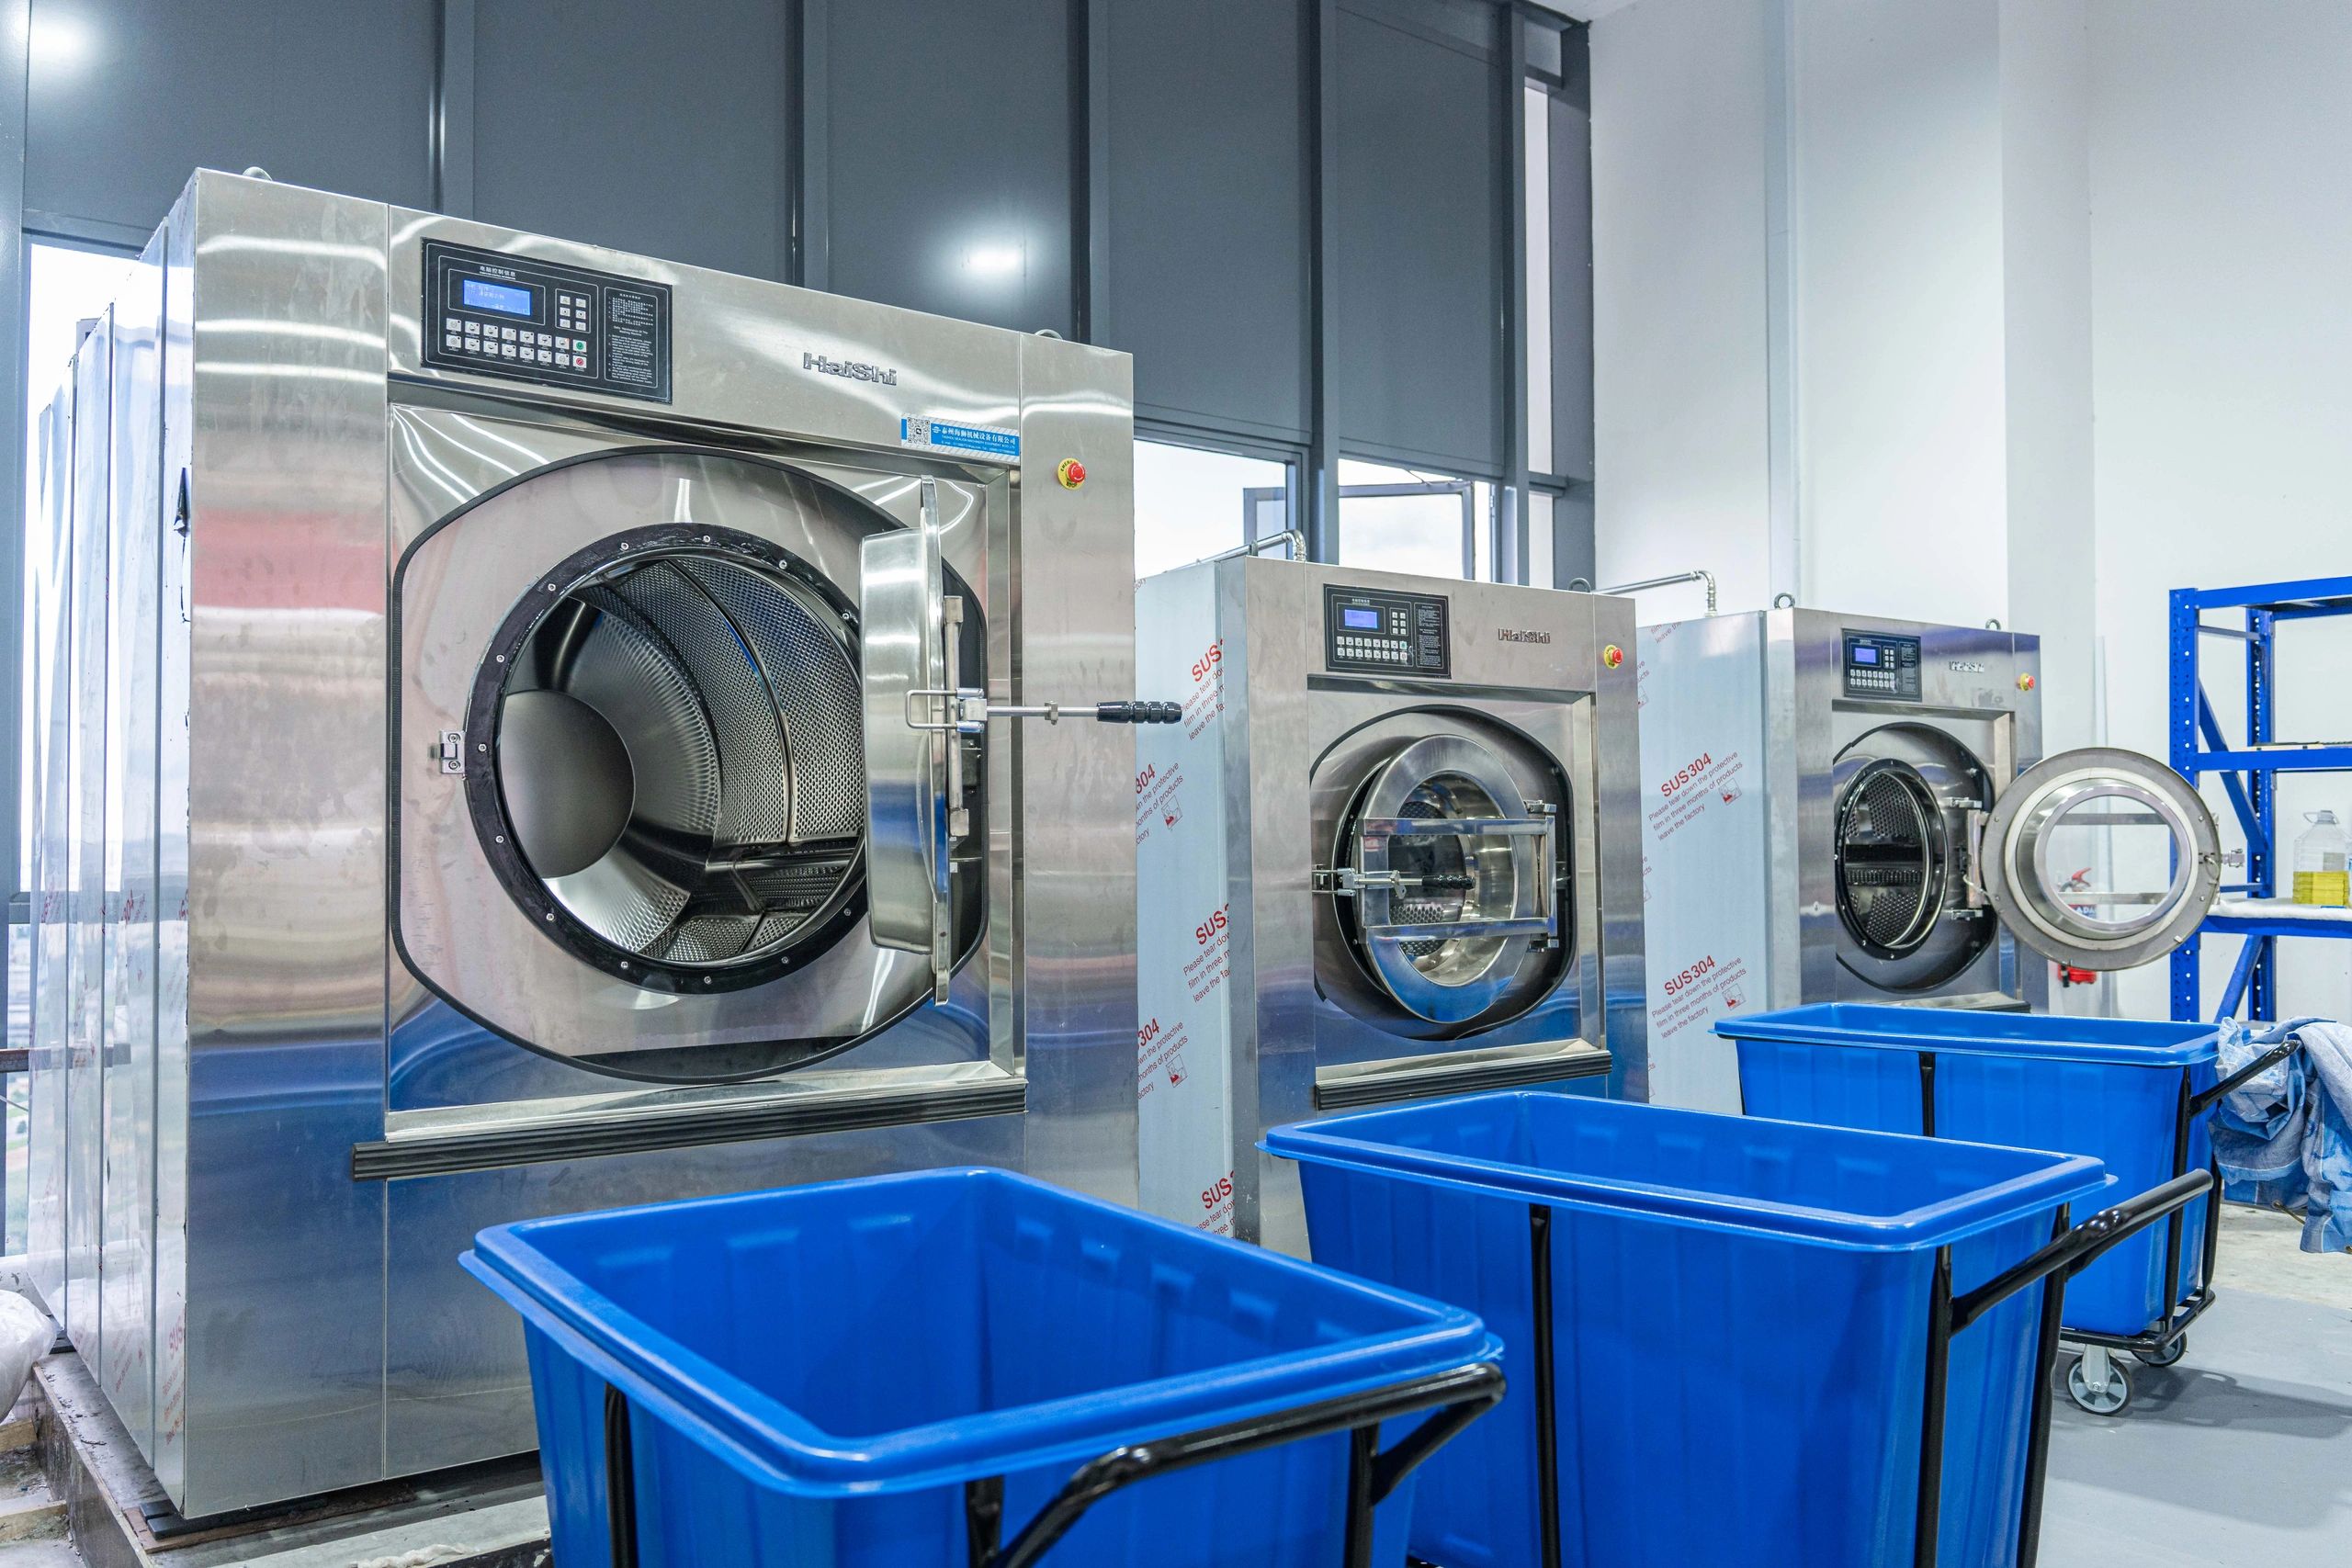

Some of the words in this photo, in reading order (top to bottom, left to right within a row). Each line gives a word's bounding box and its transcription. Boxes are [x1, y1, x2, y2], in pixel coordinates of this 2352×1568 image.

[803, 352, 897, 386] HaiShi
[1192, 638, 1224, 682] SUS
[1183, 714, 1195, 728] film
[1194, 706, 1202, 716] in
[1202, 691, 1218, 709] three
[1188, 720, 1205, 740] leave
[1204, 709, 1216, 723] the
[1142, 791, 1152, 804] the
[1152, 762, 1179, 794] protective
[1153, 799, 1159, 809] of
[1159, 774, 1183, 805] products
[1648, 803, 1669, 821] Please
[1668, 795, 1681, 807] tear
[1681, 784, 1698, 797] down
[1697, 774, 1708, 785] the
[1708, 751, 1738, 778] protective
[1660, 752, 1712, 797] SUS304
[1653, 819, 1665, 831] film
[1665, 815, 1671, 824] in
[1670, 804, 1687, 818] three
[1687, 788, 1709, 807] months
[1709, 780, 1716, 790] of
[1716, 761, 1743, 785] products
[1657, 826, 1675, 841] leave
[1674, 818, 1685, 829] the
[1684, 803, 1705, 822] factory
[1195, 903, 1229, 945] SUS
[1183, 954, 1204, 976] Please
[1204, 943, 1216, 958] tear
[1188, 976, 1200, 989] film
[1199, 970, 1206, 979] in
[1205, 956, 1223, 974] three
[1664, 954, 1715, 996] SUS304
[1193, 985, 1210, 1003] leave
[1209, 976, 1220, 988] the
[1651, 1001, 1672, 1018] Please
[1672, 994, 1684, 1005] tear
[1684, 984, 1701, 997] down
[1701, 976, 1712, 987] the
[1711, 956, 1742, 981] protective
[1656, 1017, 1668, 1029] film
[1668, 1013, 1675, 1021] in
[1674, 1004, 1690, 1017] three
[1690, 990, 1713, 1007] months
[1713, 983, 1720, 993] of
[1720, 967, 1747, 990] products
[1147, 1046, 1157, 1057] the
[1156, 1021, 1183, 1051] protective
[1661, 1026, 1678, 1039] leave
[1677, 1019, 1688, 1029] the
[1688, 1006, 1709, 1022] factory
[1157, 1055, 1163, 1065] of
[1163, 1035, 1189, 1062] products
[1202, 1169, 1234, 1209] SUS
[1209, 1210, 1222, 1223] tear
